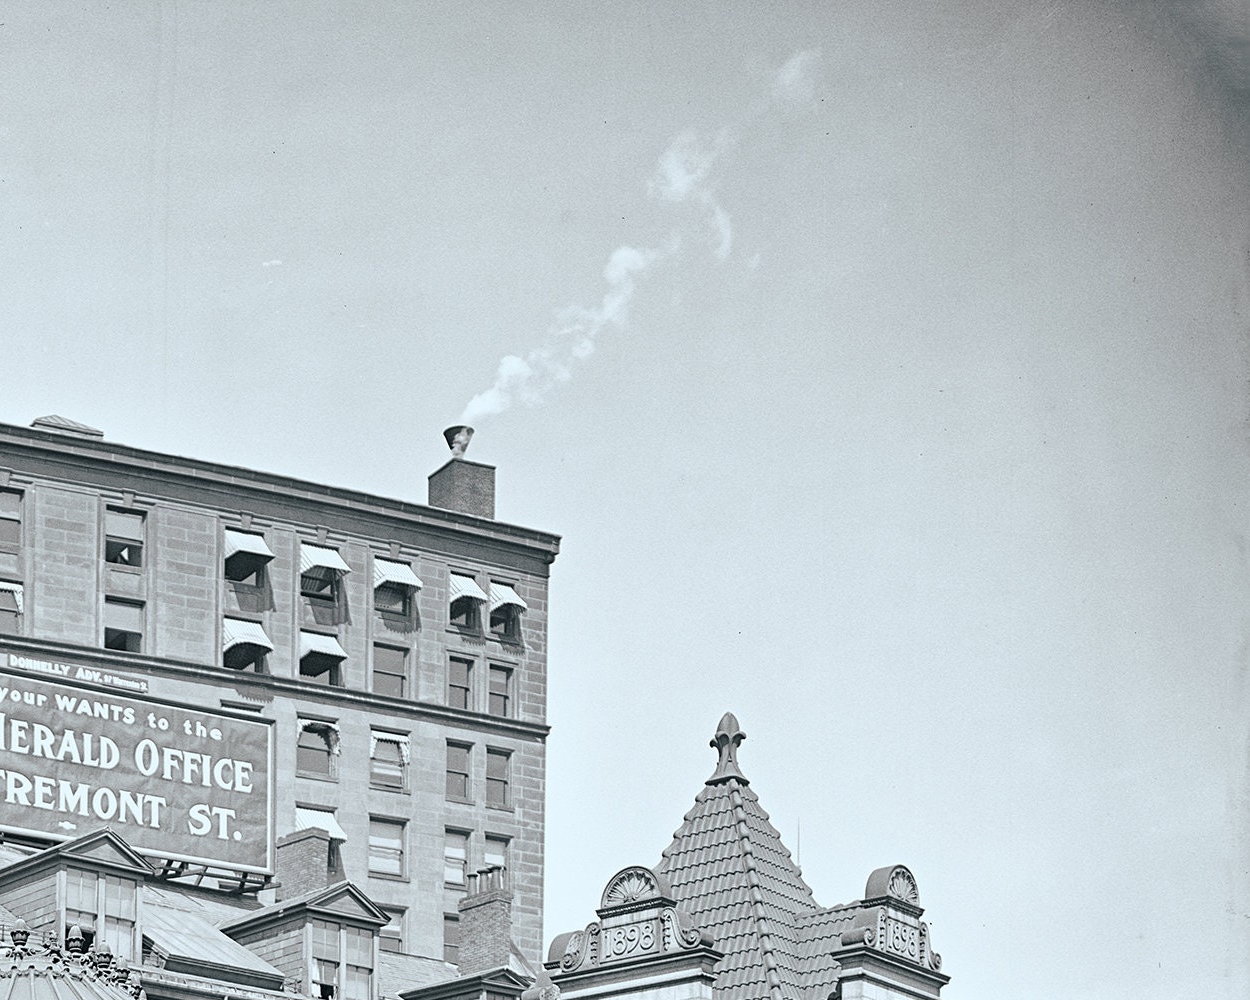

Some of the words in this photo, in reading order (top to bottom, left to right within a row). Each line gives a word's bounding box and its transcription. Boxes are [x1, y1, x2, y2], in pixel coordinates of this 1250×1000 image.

[9, 653, 70, 676] DONNELLY
[75, 667, 104, 683] ADV.
[54, 694, 136, 725] WANTS
[147, 711, 170, 731] to
[183, 719, 223, 741] the
[134, 738, 254, 794] OFFICE
[187, 803, 243, 842] ST.
[604, 922, 656, 958] 1898
[887, 919, 918, 958] 1898
